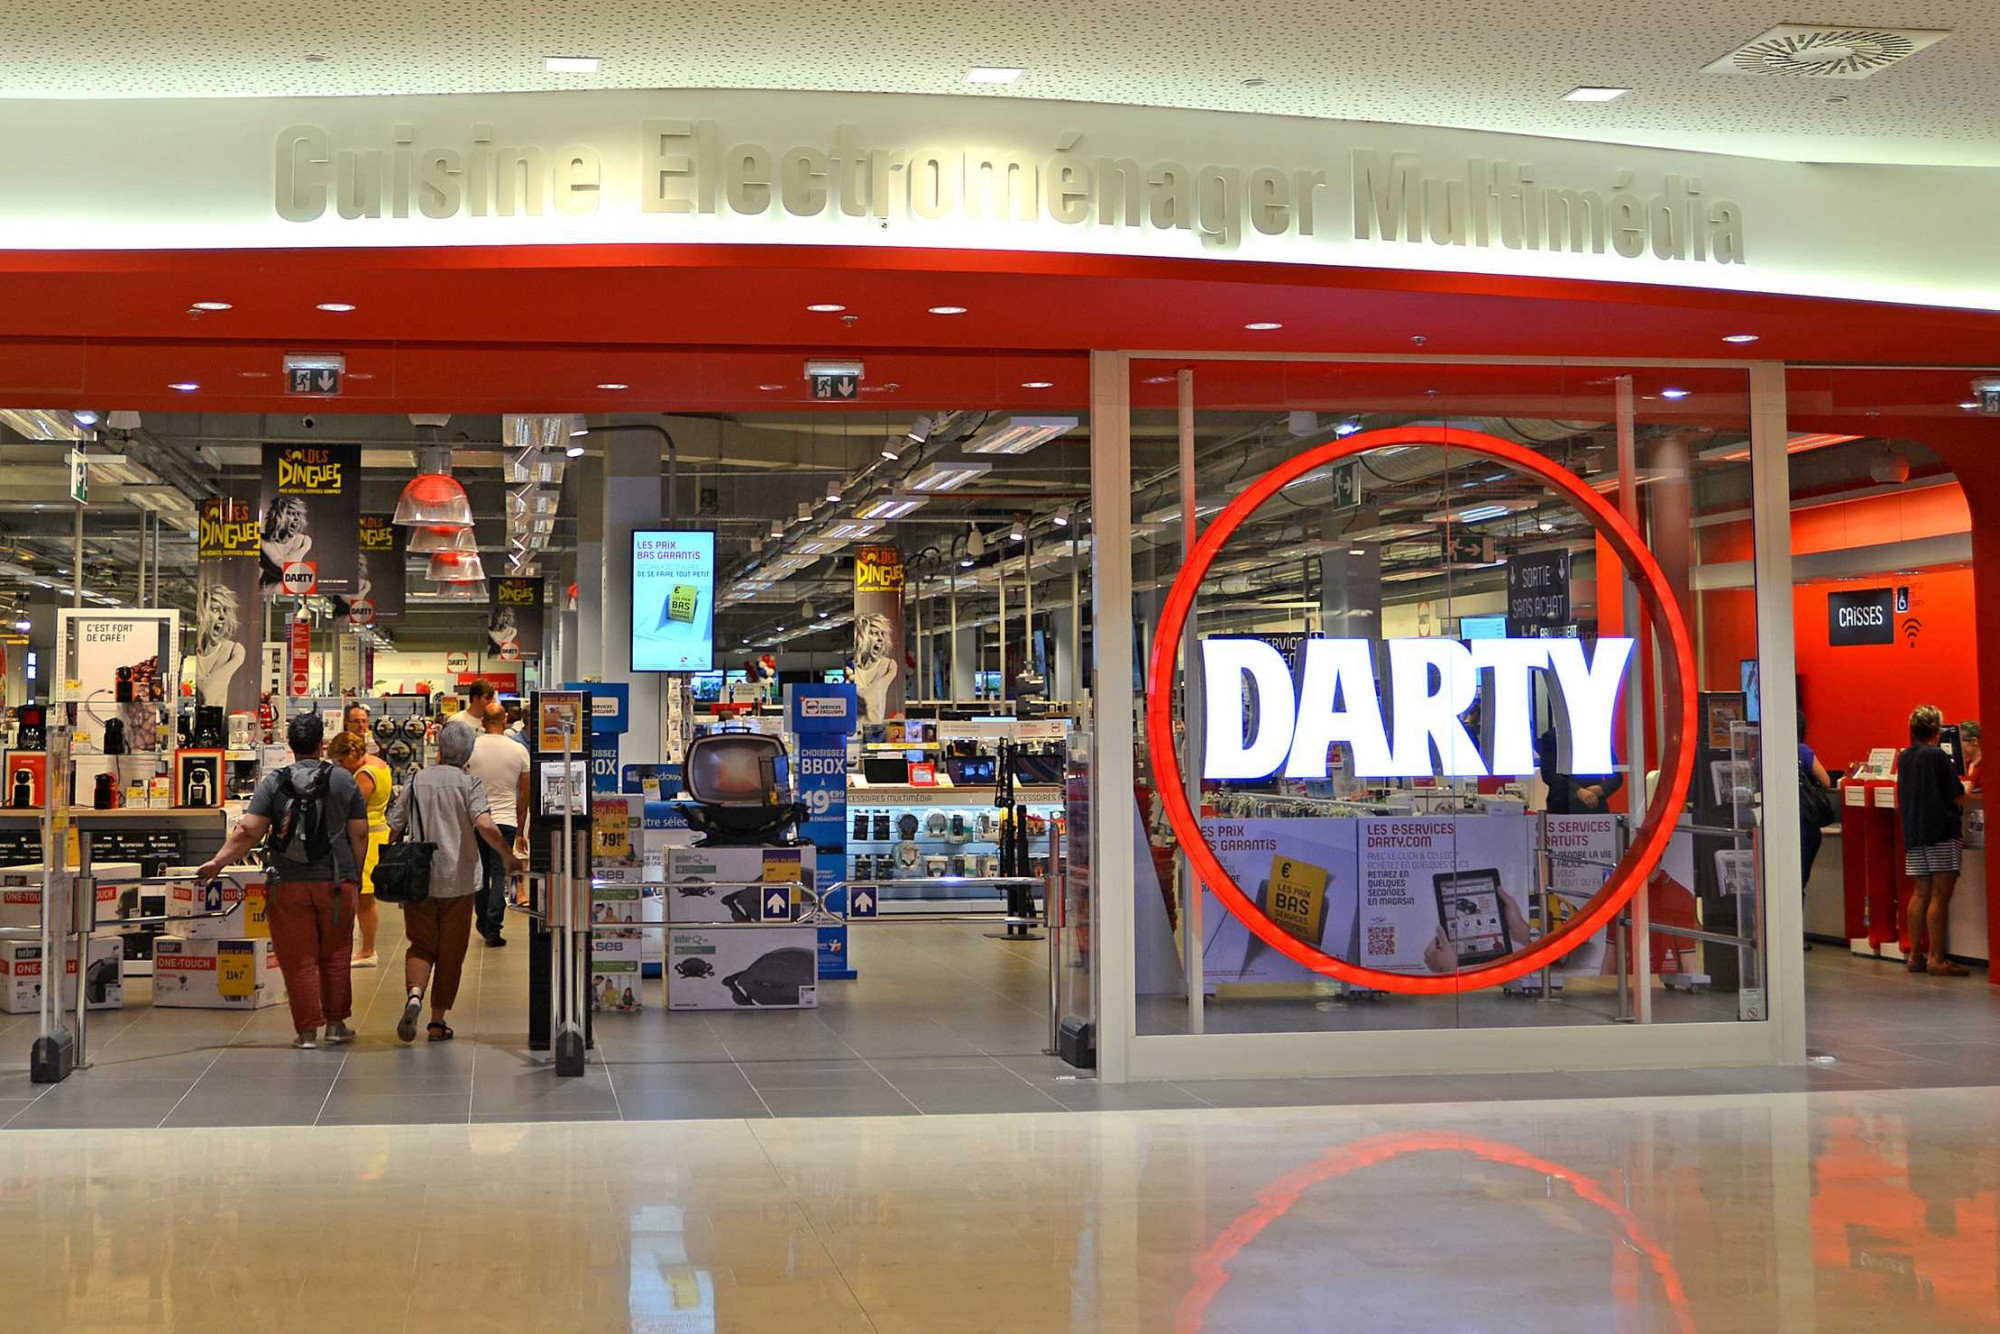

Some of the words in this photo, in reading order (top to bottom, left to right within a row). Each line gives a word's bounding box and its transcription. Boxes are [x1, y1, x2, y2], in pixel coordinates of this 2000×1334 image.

[275, 122, 600, 223] Cuisine
[642, 119, 1327, 252] Electroménager
[1351, 148, 1746, 265] Multimédia
[278, 457, 342, 488] DINGUES
[200, 516, 261, 549] DINGUES
[359, 527, 392, 546] NGUES
[637, 541, 653, 549] LES
[637, 552, 655, 560] BAS
[856, 559, 904, 586] DINGUES
[285, 573, 314, 583] DARTY
[672, 600, 690, 610] BAS
[1512, 597, 1533, 619] SANS
[86, 624, 109, 632] C'EST
[112, 624, 133, 632] FORT
[86, 634, 97, 642] DE
[1201, 638, 1636, 780] DARTY
[592, 750, 616, 758] SISSEZ
[801, 759, 845, 774] BBOX
[1202, 826, 1214, 837] ES
[1367, 824, 1387, 835] LES
[1367, 836, 1432, 848] DARTY.COM
[1589, 851, 1598, 859] LA
[1281, 862, 1291, 879] €
[1277, 884, 1290, 893] LES
[1367, 879, 1406, 888] QUELQUES
[5, 892, 40, 902] ONE-TOU
[1367, 897, 1378, 906] EN
[1276, 893, 1309, 916] BAS
[158, 959, 211, 968] ONE-TOUCH
